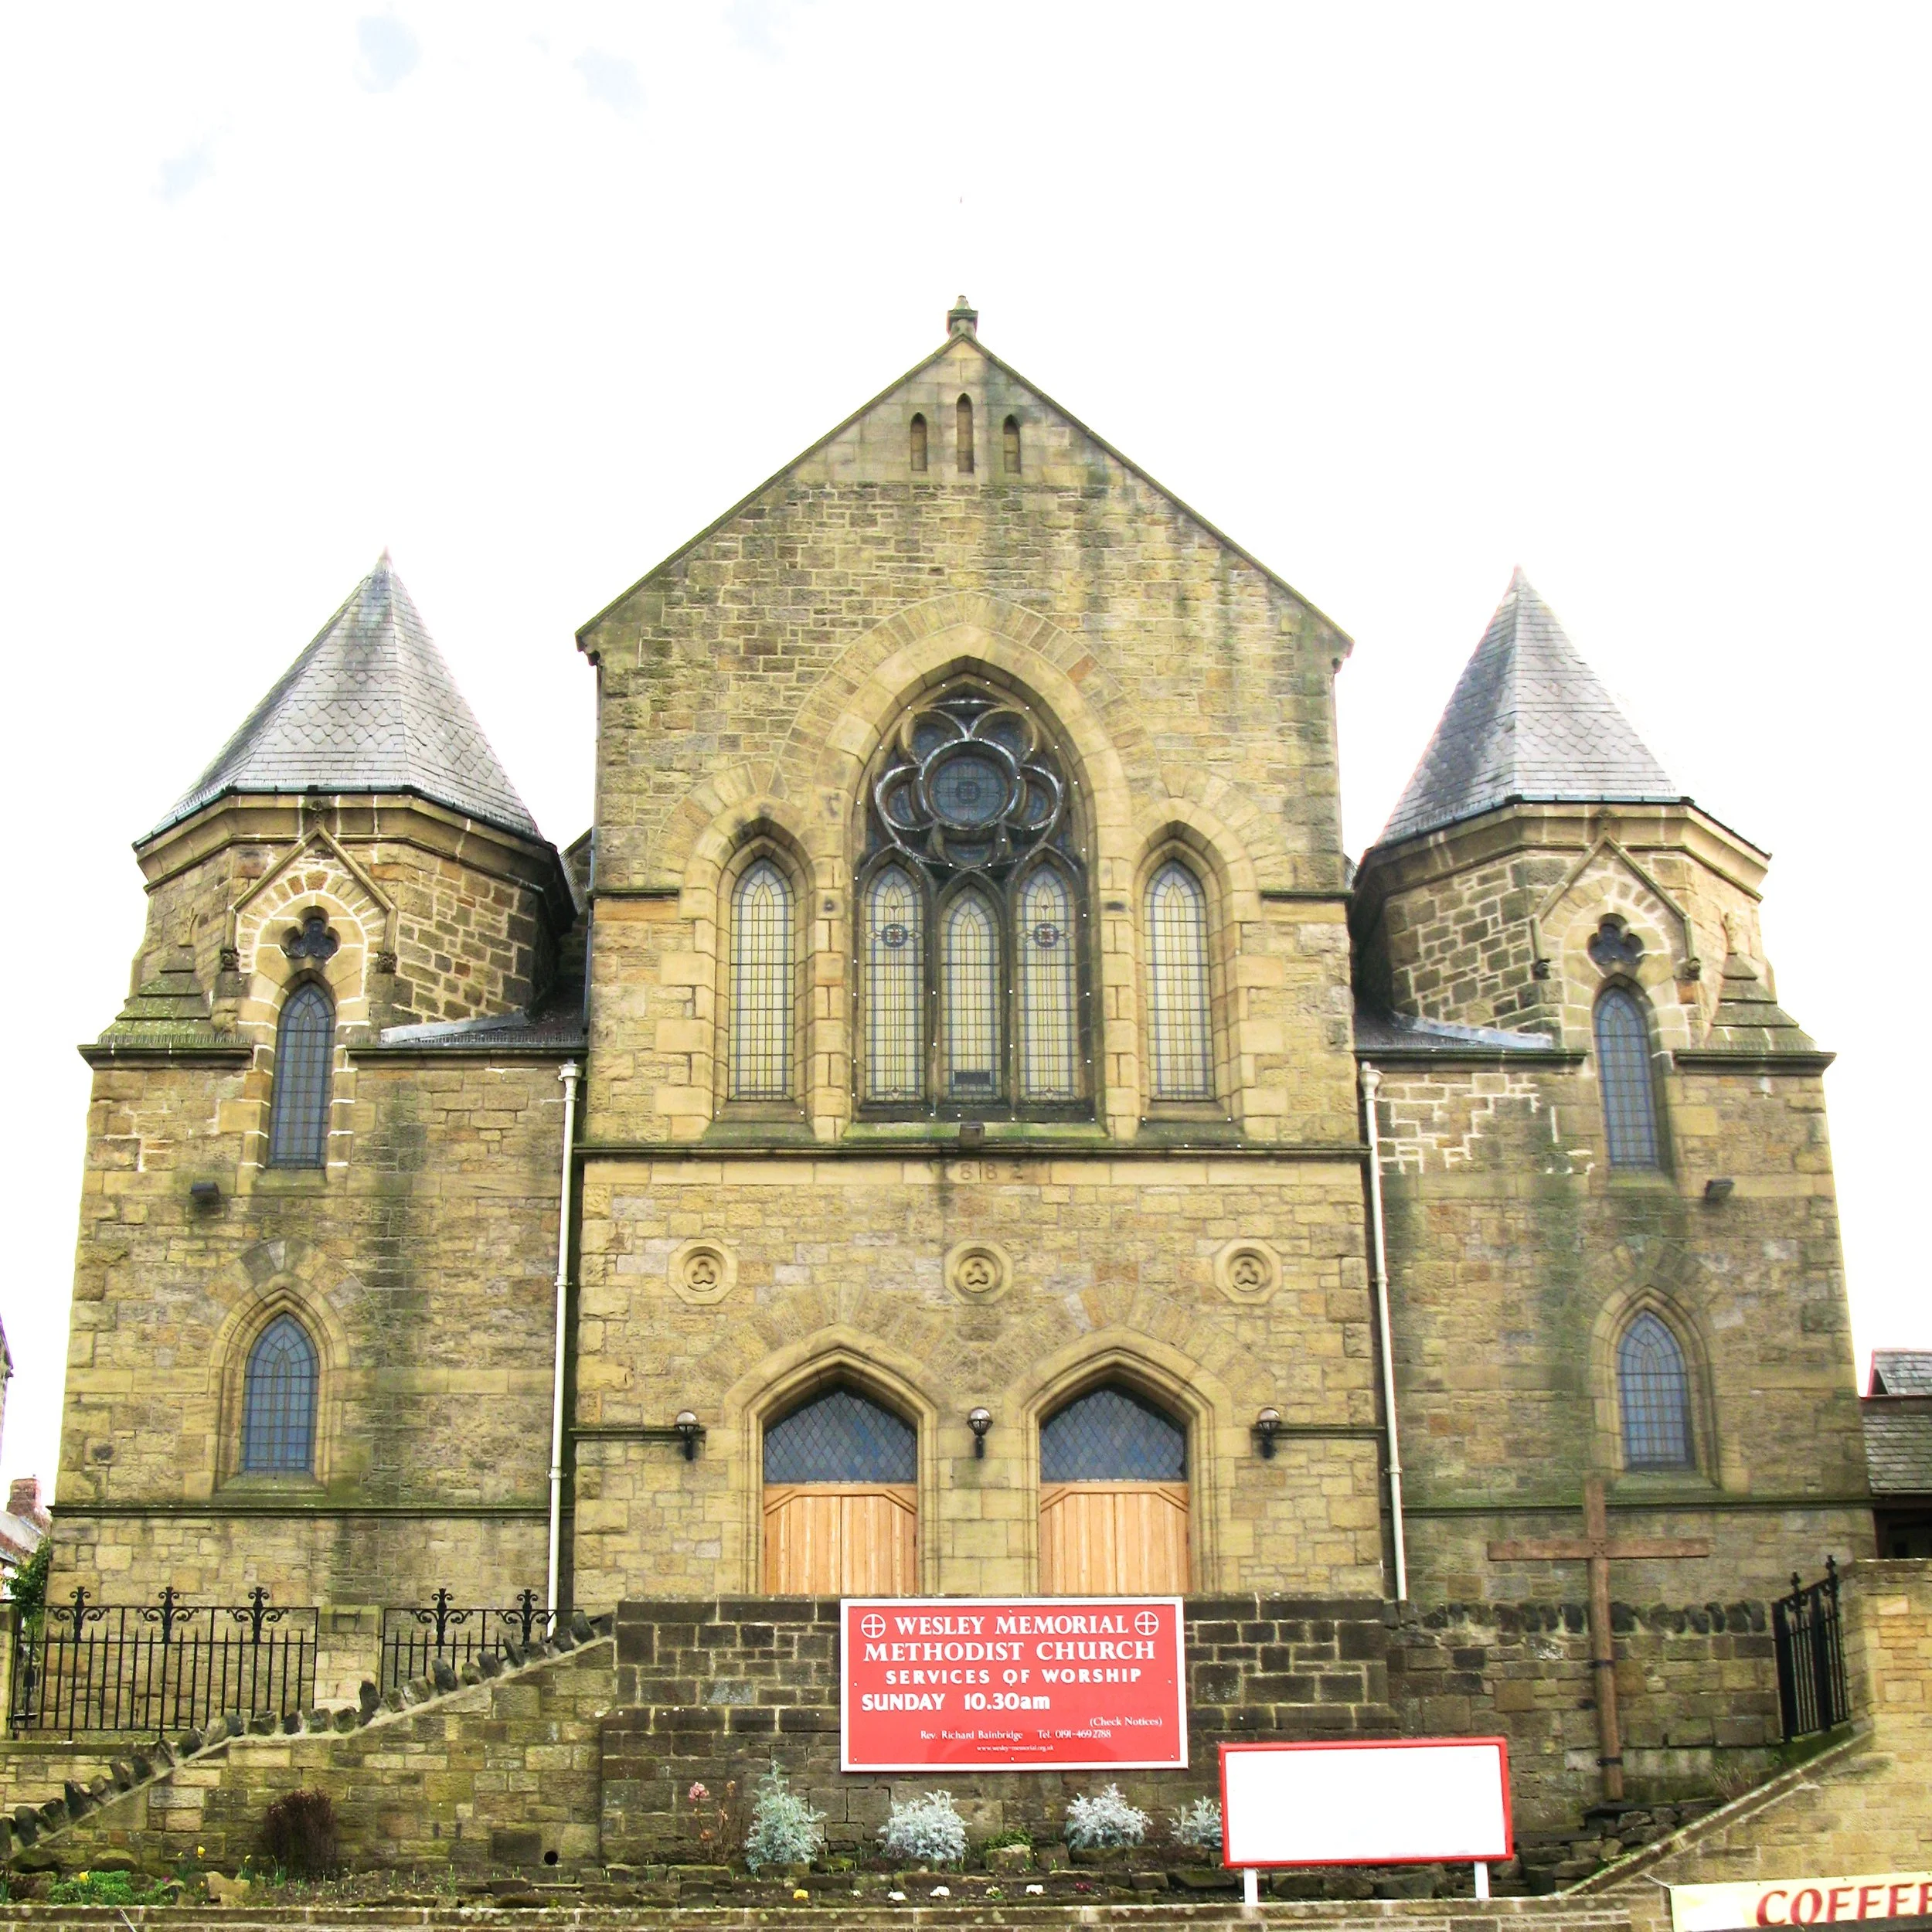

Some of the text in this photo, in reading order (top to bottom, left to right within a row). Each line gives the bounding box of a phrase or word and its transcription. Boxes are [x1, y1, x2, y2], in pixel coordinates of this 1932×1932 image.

[894, 1614, 1129, 1635] WESLEY MEMORIAL
[863, 1641, 1155, 1662] METHODIST CHURCH
[886, 1668, 1142, 1685] SERVICES OF WORSHIP
[862, 1692, 1051, 1711] SUNDAY 10.30am
[1089, 1716, 1163, 1727] (Check Notices)
[920, 1730, 937, 1740] Rev.
[941, 1730, 975, 1740] Richard
[978, 1730, 1023, 1742] Bainbridge
[1036, 1729, 1051, 1739] Tel.
